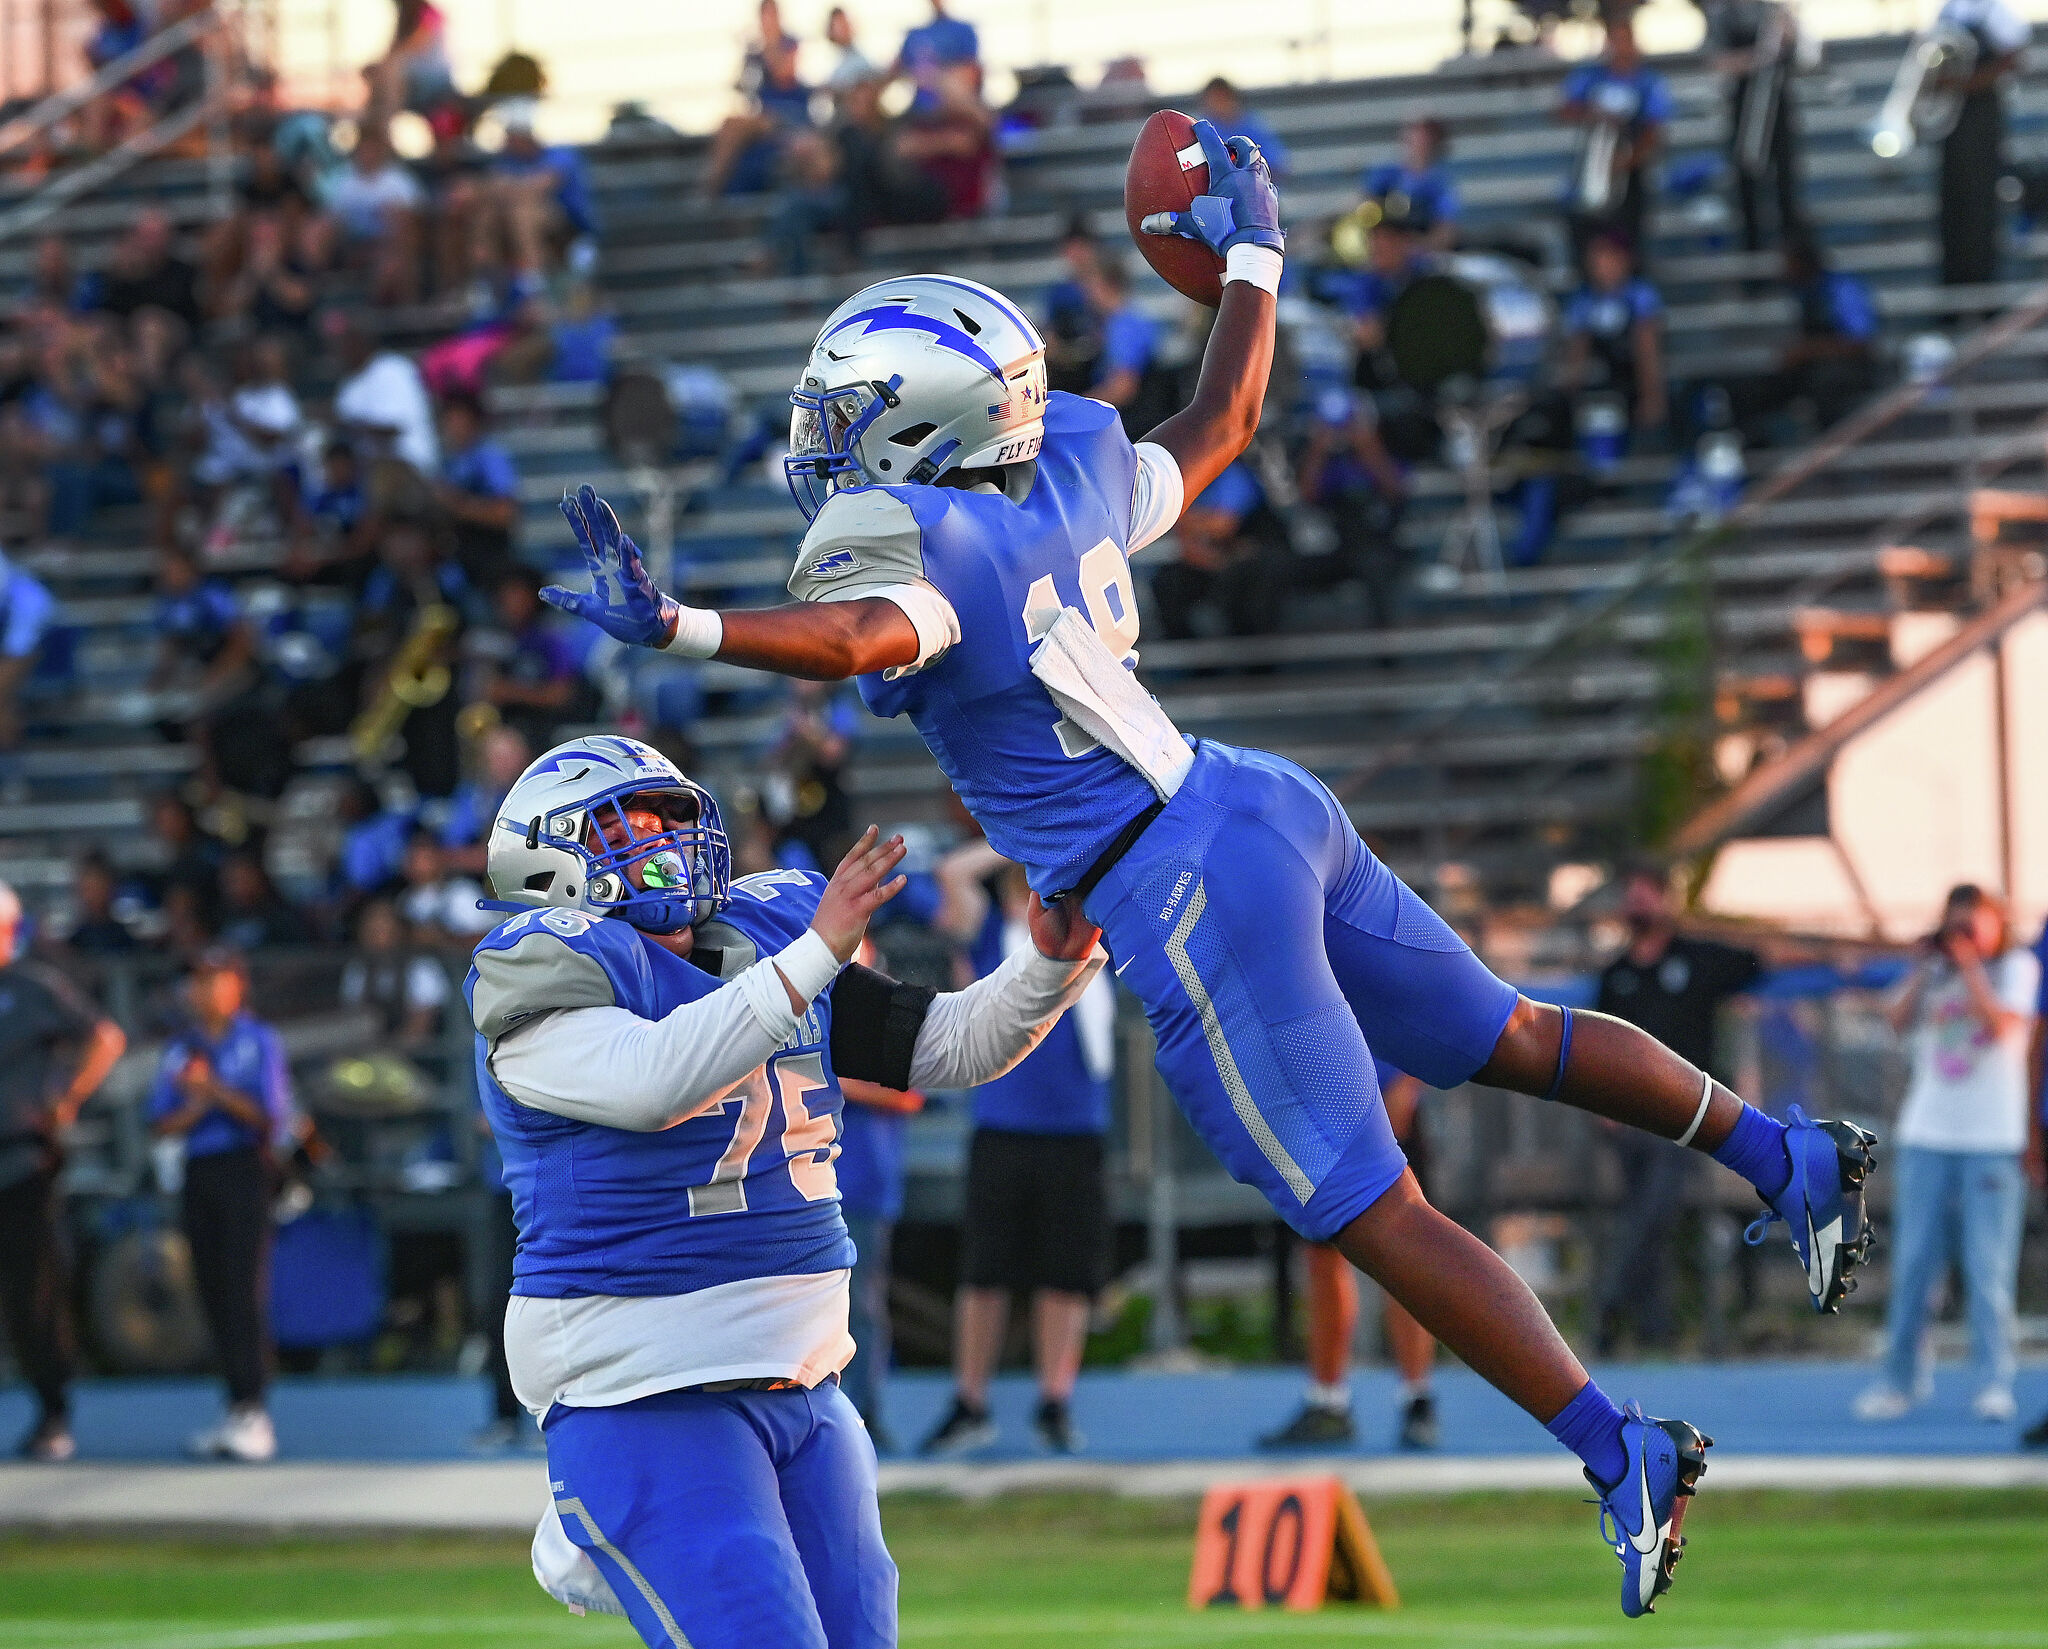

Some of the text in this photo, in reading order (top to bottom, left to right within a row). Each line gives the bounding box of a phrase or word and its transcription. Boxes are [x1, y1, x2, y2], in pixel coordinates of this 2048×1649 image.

[994, 441, 1025, 463] FLY
[1159, 870, 1193, 922] RO-HAWKS
[687, 1051, 843, 1218] 75
[1207, 1495, 1305, 1605] 10
